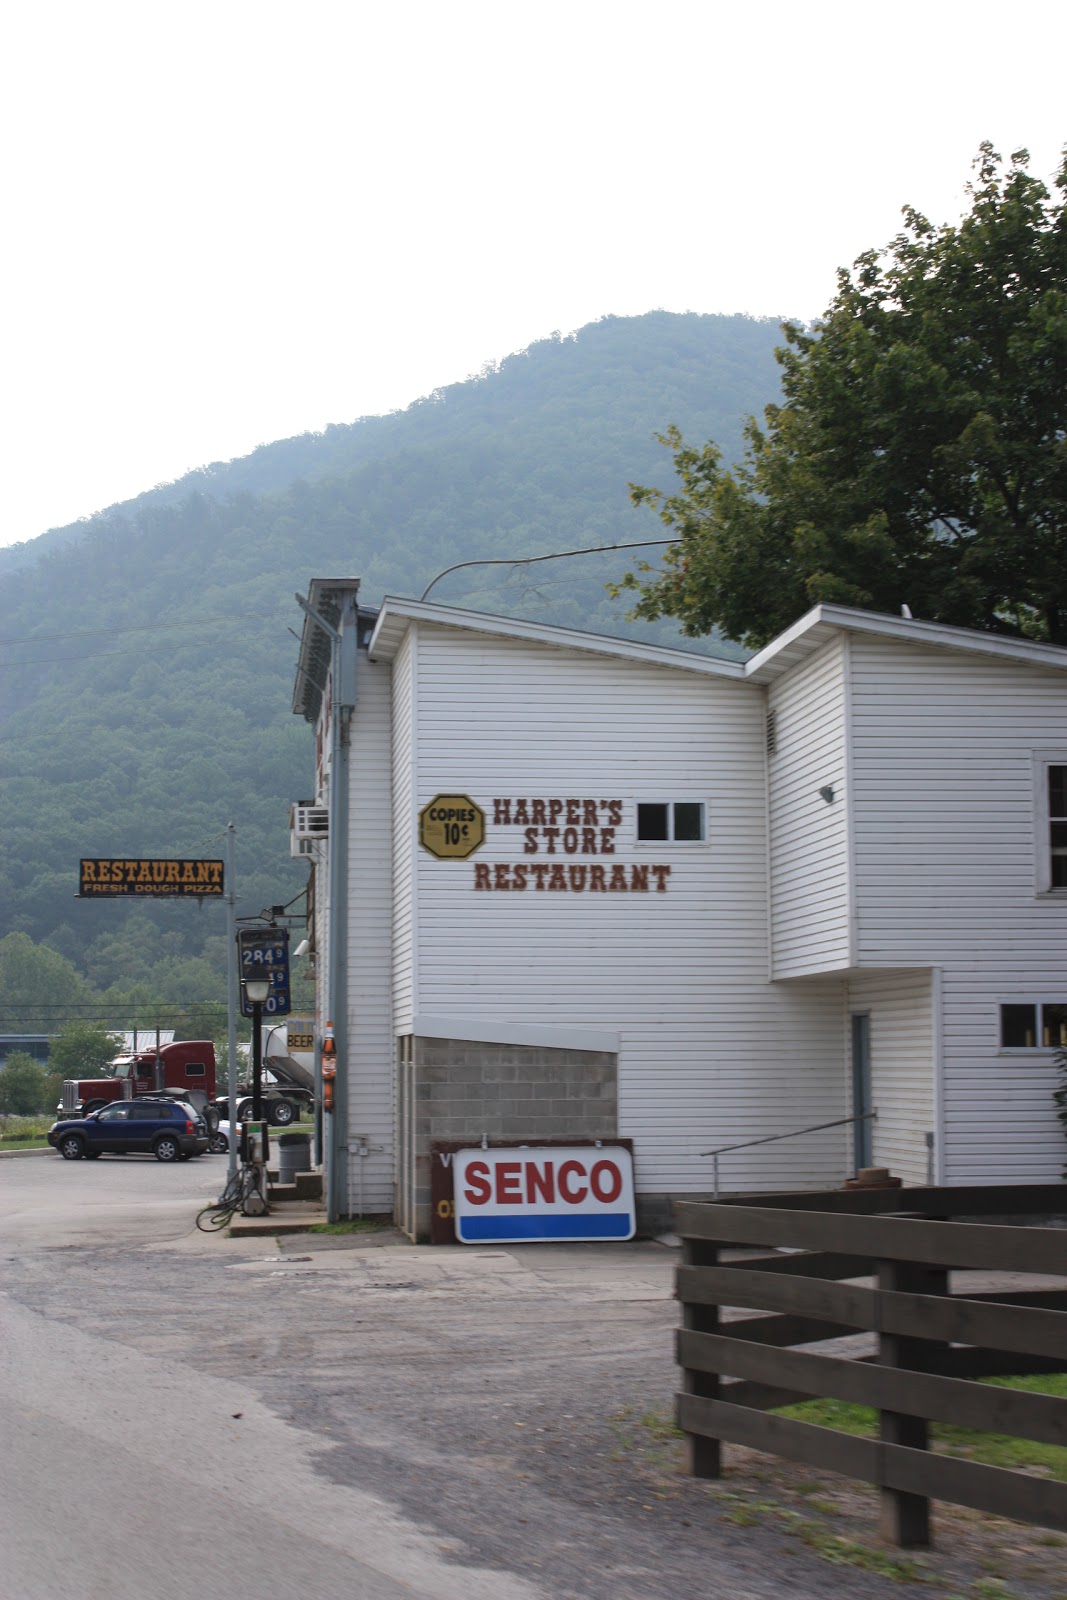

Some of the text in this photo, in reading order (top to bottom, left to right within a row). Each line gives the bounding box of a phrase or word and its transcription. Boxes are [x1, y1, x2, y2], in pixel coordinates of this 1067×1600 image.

[429, 808, 475, 822] COPIES
[493, 798, 623, 826] HARPER'S
[524, 827, 615, 855] STORE
[81, 861, 223, 882] RESTAURANT
[474, 863, 671, 893] RESTAURANT
[83, 884, 222, 893] FRESH DOUGH PIZZA
[288, 1034, 314, 1048] BEER
[464, 1160, 622, 1205] SENCO
